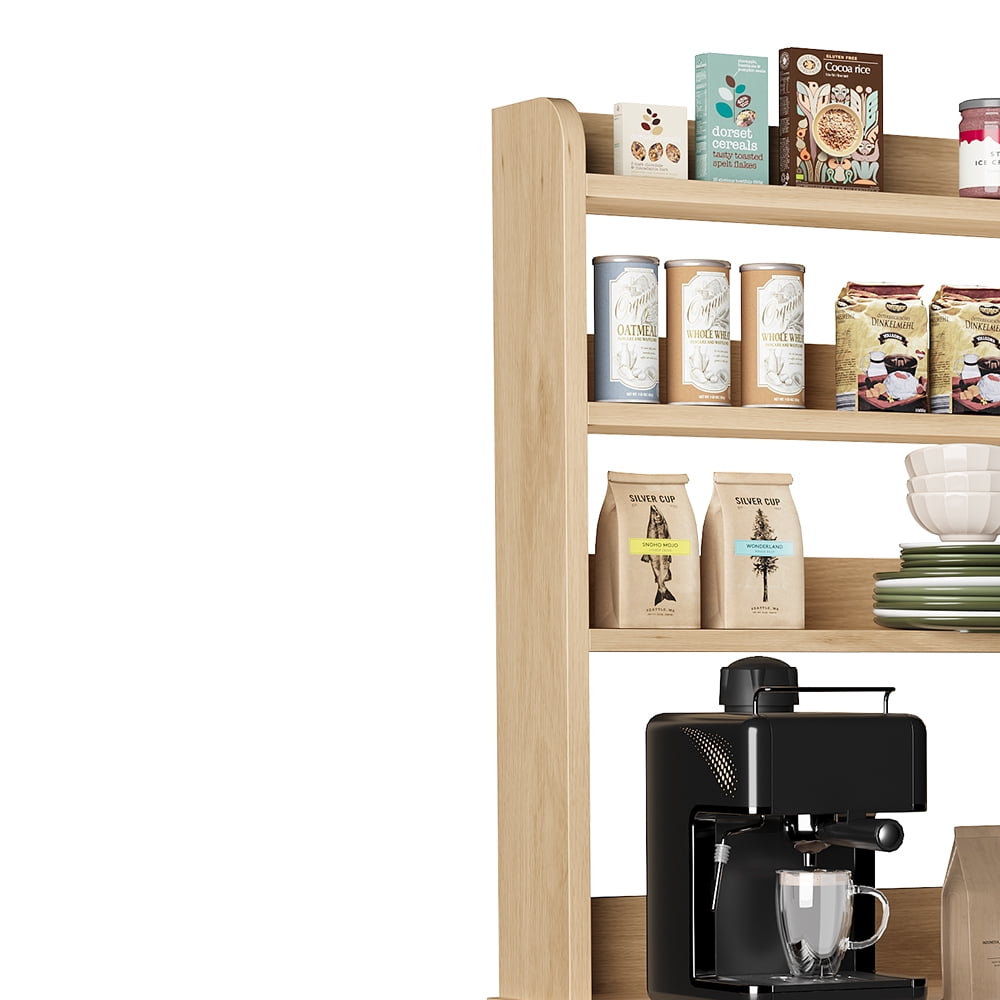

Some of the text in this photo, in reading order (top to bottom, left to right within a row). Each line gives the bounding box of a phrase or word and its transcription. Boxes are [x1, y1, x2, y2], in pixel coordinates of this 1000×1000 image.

[825, 62, 853, 73] Cocoa
[855, 65, 871, 75] rice
[712, 126, 753, 139] dorset
[712, 140, 758, 151] cereals
[713, 151, 763, 160] tasty toasted
[713, 160, 757, 169] spelt flakes
[871, 316, 915, 330] DINKELMEHL
[687, 330, 713, 339] WHOLE
[762, 333, 788, 342] WHOLE
[629, 495, 676, 503] SILVER CUP
[735, 497, 781, 506] SILVER CUP
